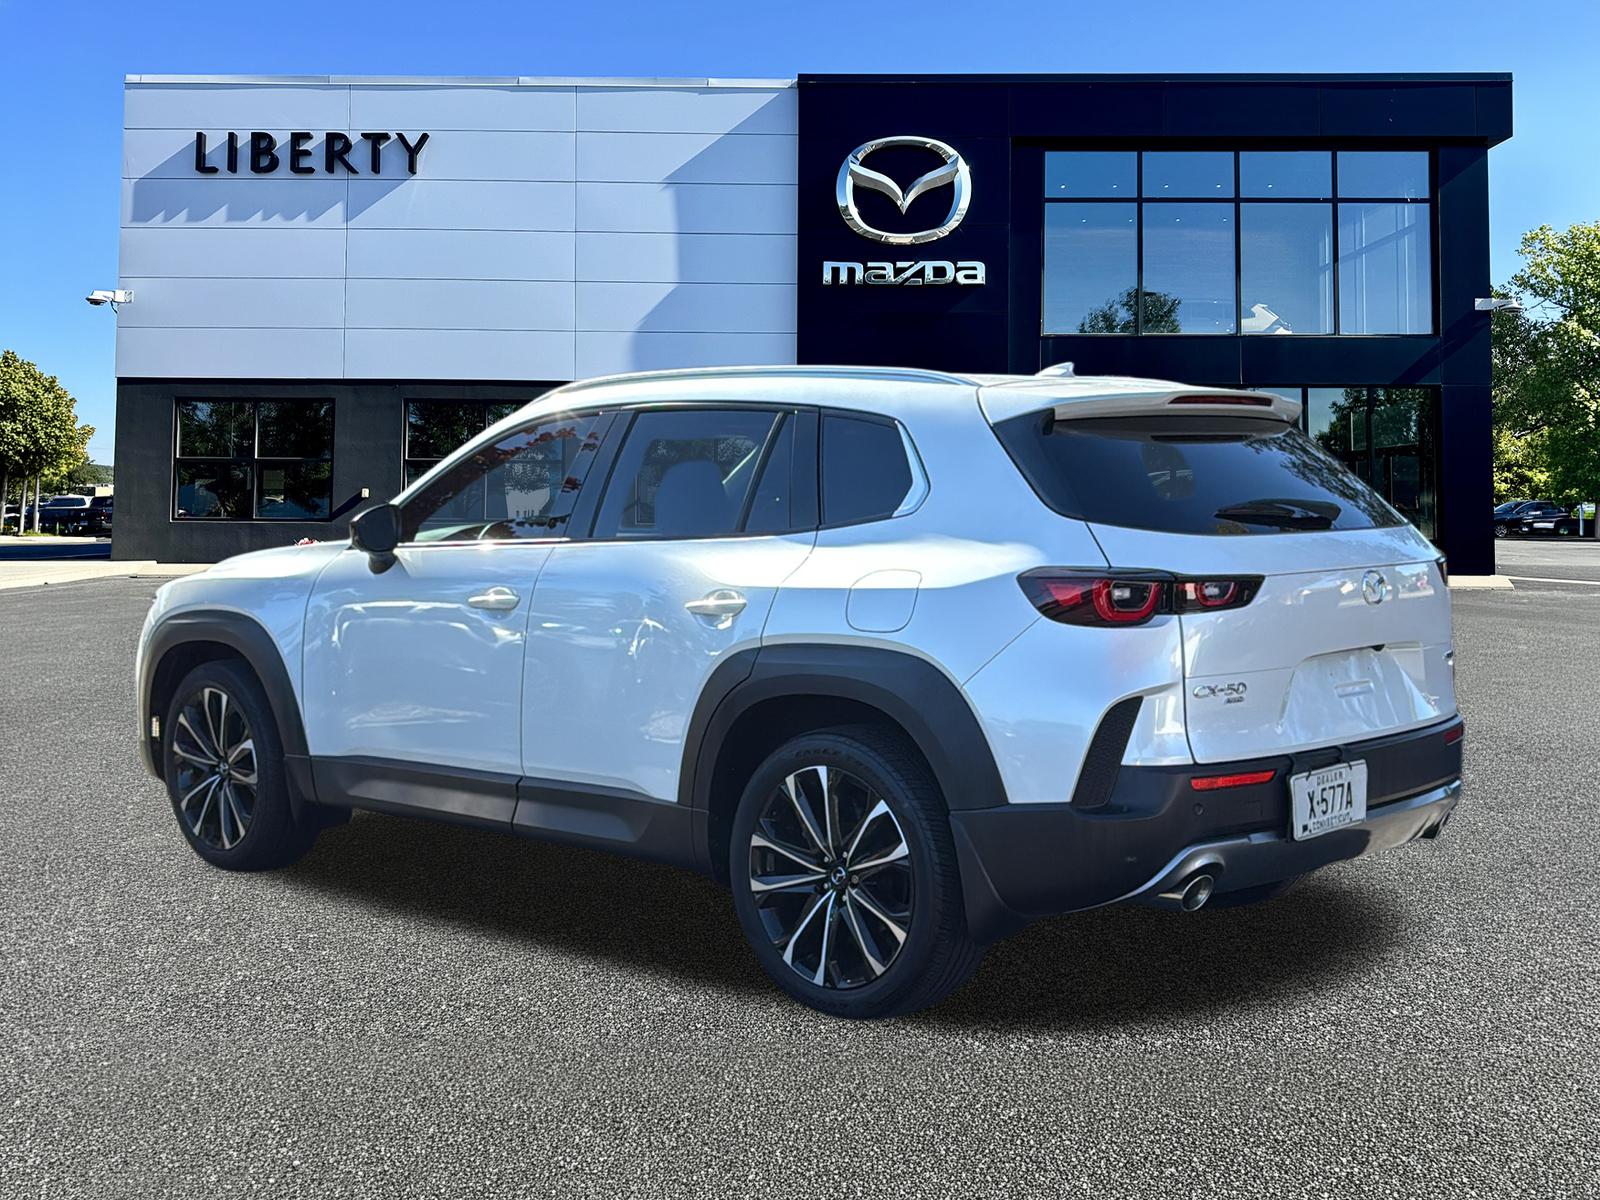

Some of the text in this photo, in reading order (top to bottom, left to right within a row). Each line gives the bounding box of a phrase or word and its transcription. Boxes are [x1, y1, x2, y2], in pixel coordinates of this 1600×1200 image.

[195, 131, 430, 174] LIBERTY
[822, 260, 986, 285] mazda
[1193, 682, 1247, 699] CX-50
[1316, 770, 1344, 786] DEALER
